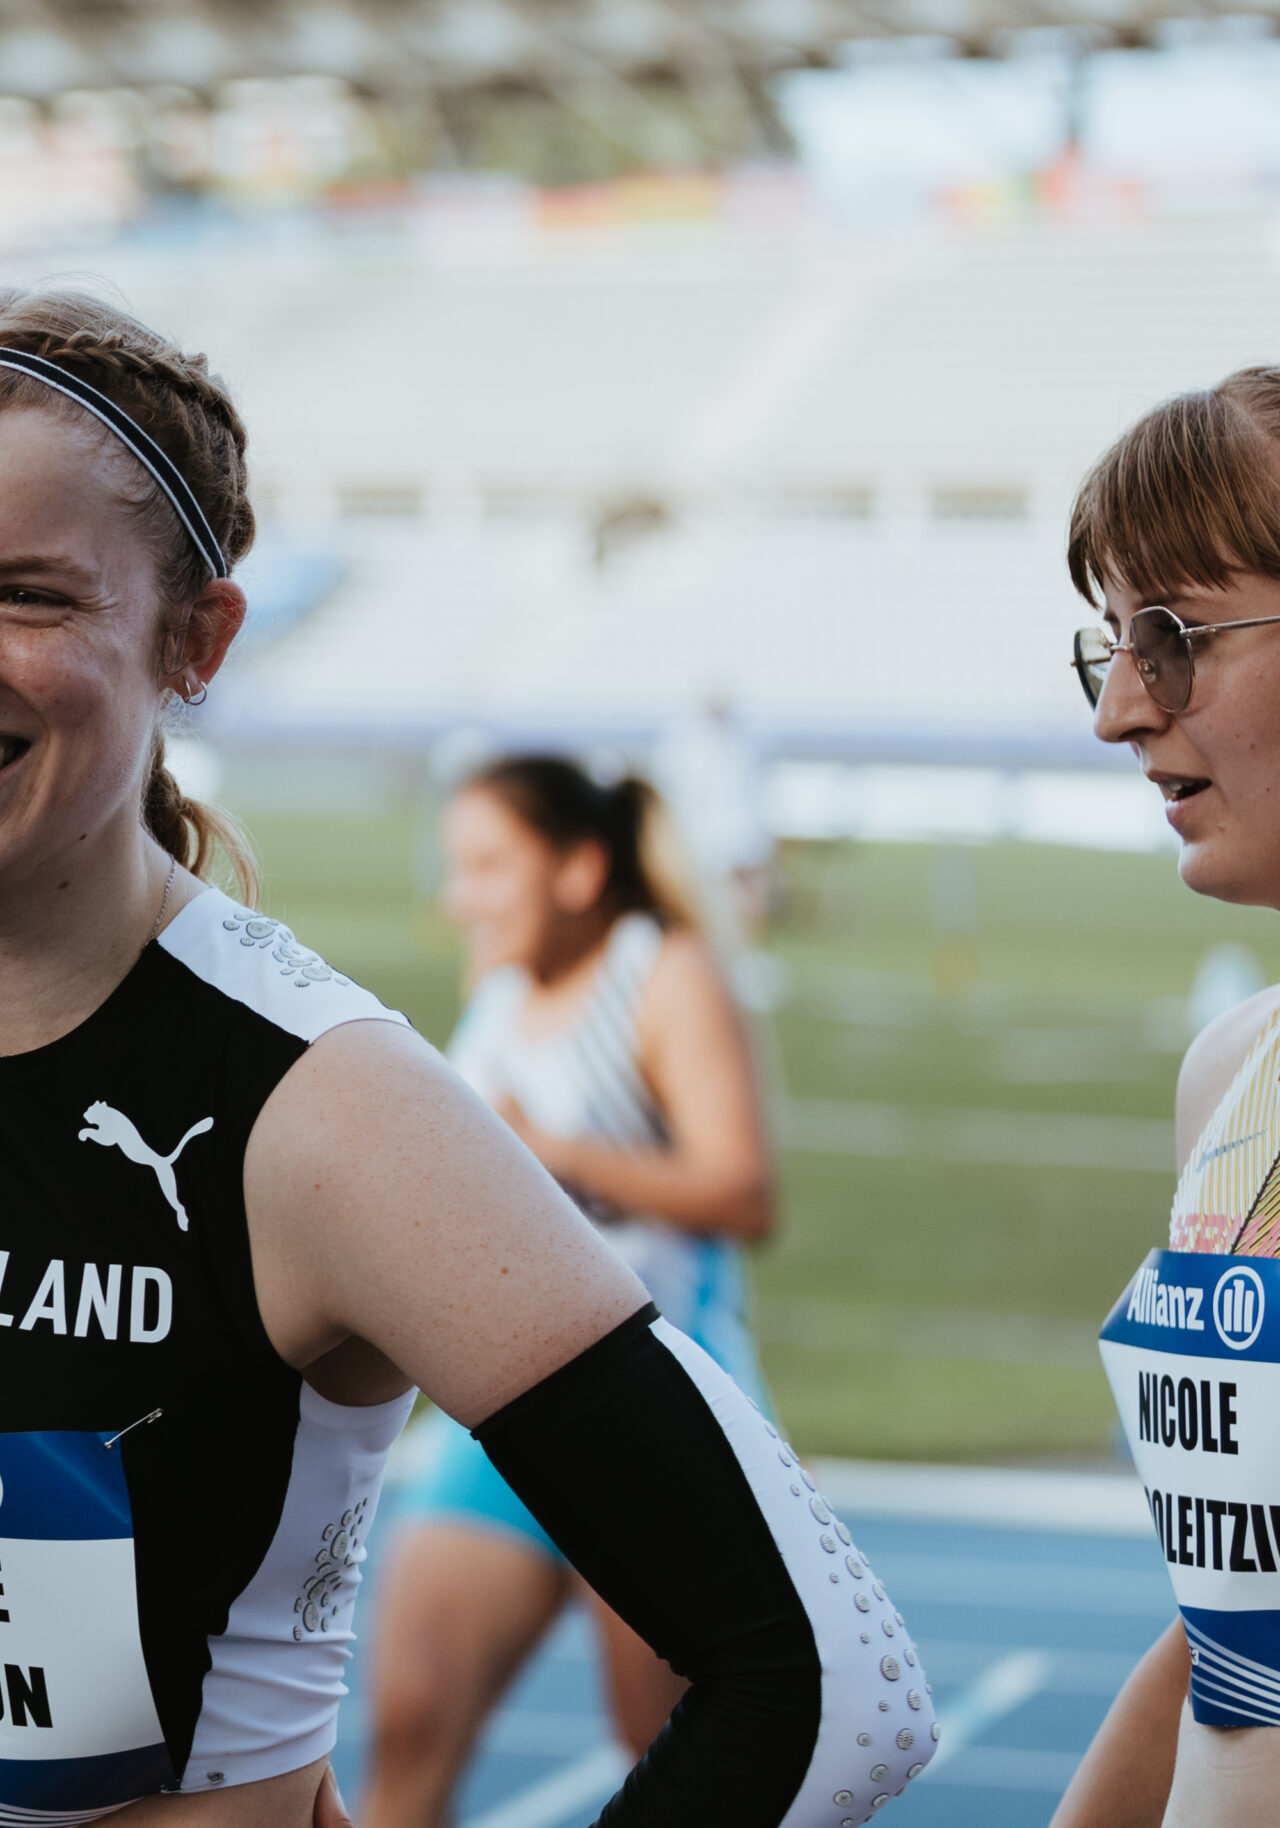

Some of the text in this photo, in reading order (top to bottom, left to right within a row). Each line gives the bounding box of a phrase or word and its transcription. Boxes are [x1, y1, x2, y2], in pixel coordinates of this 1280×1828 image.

[1126, 1268, 1205, 1331] Allianz
[1138, 1370, 1239, 1456] NICOLE
[1144, 1485, 1280, 1573] OLEITZI
